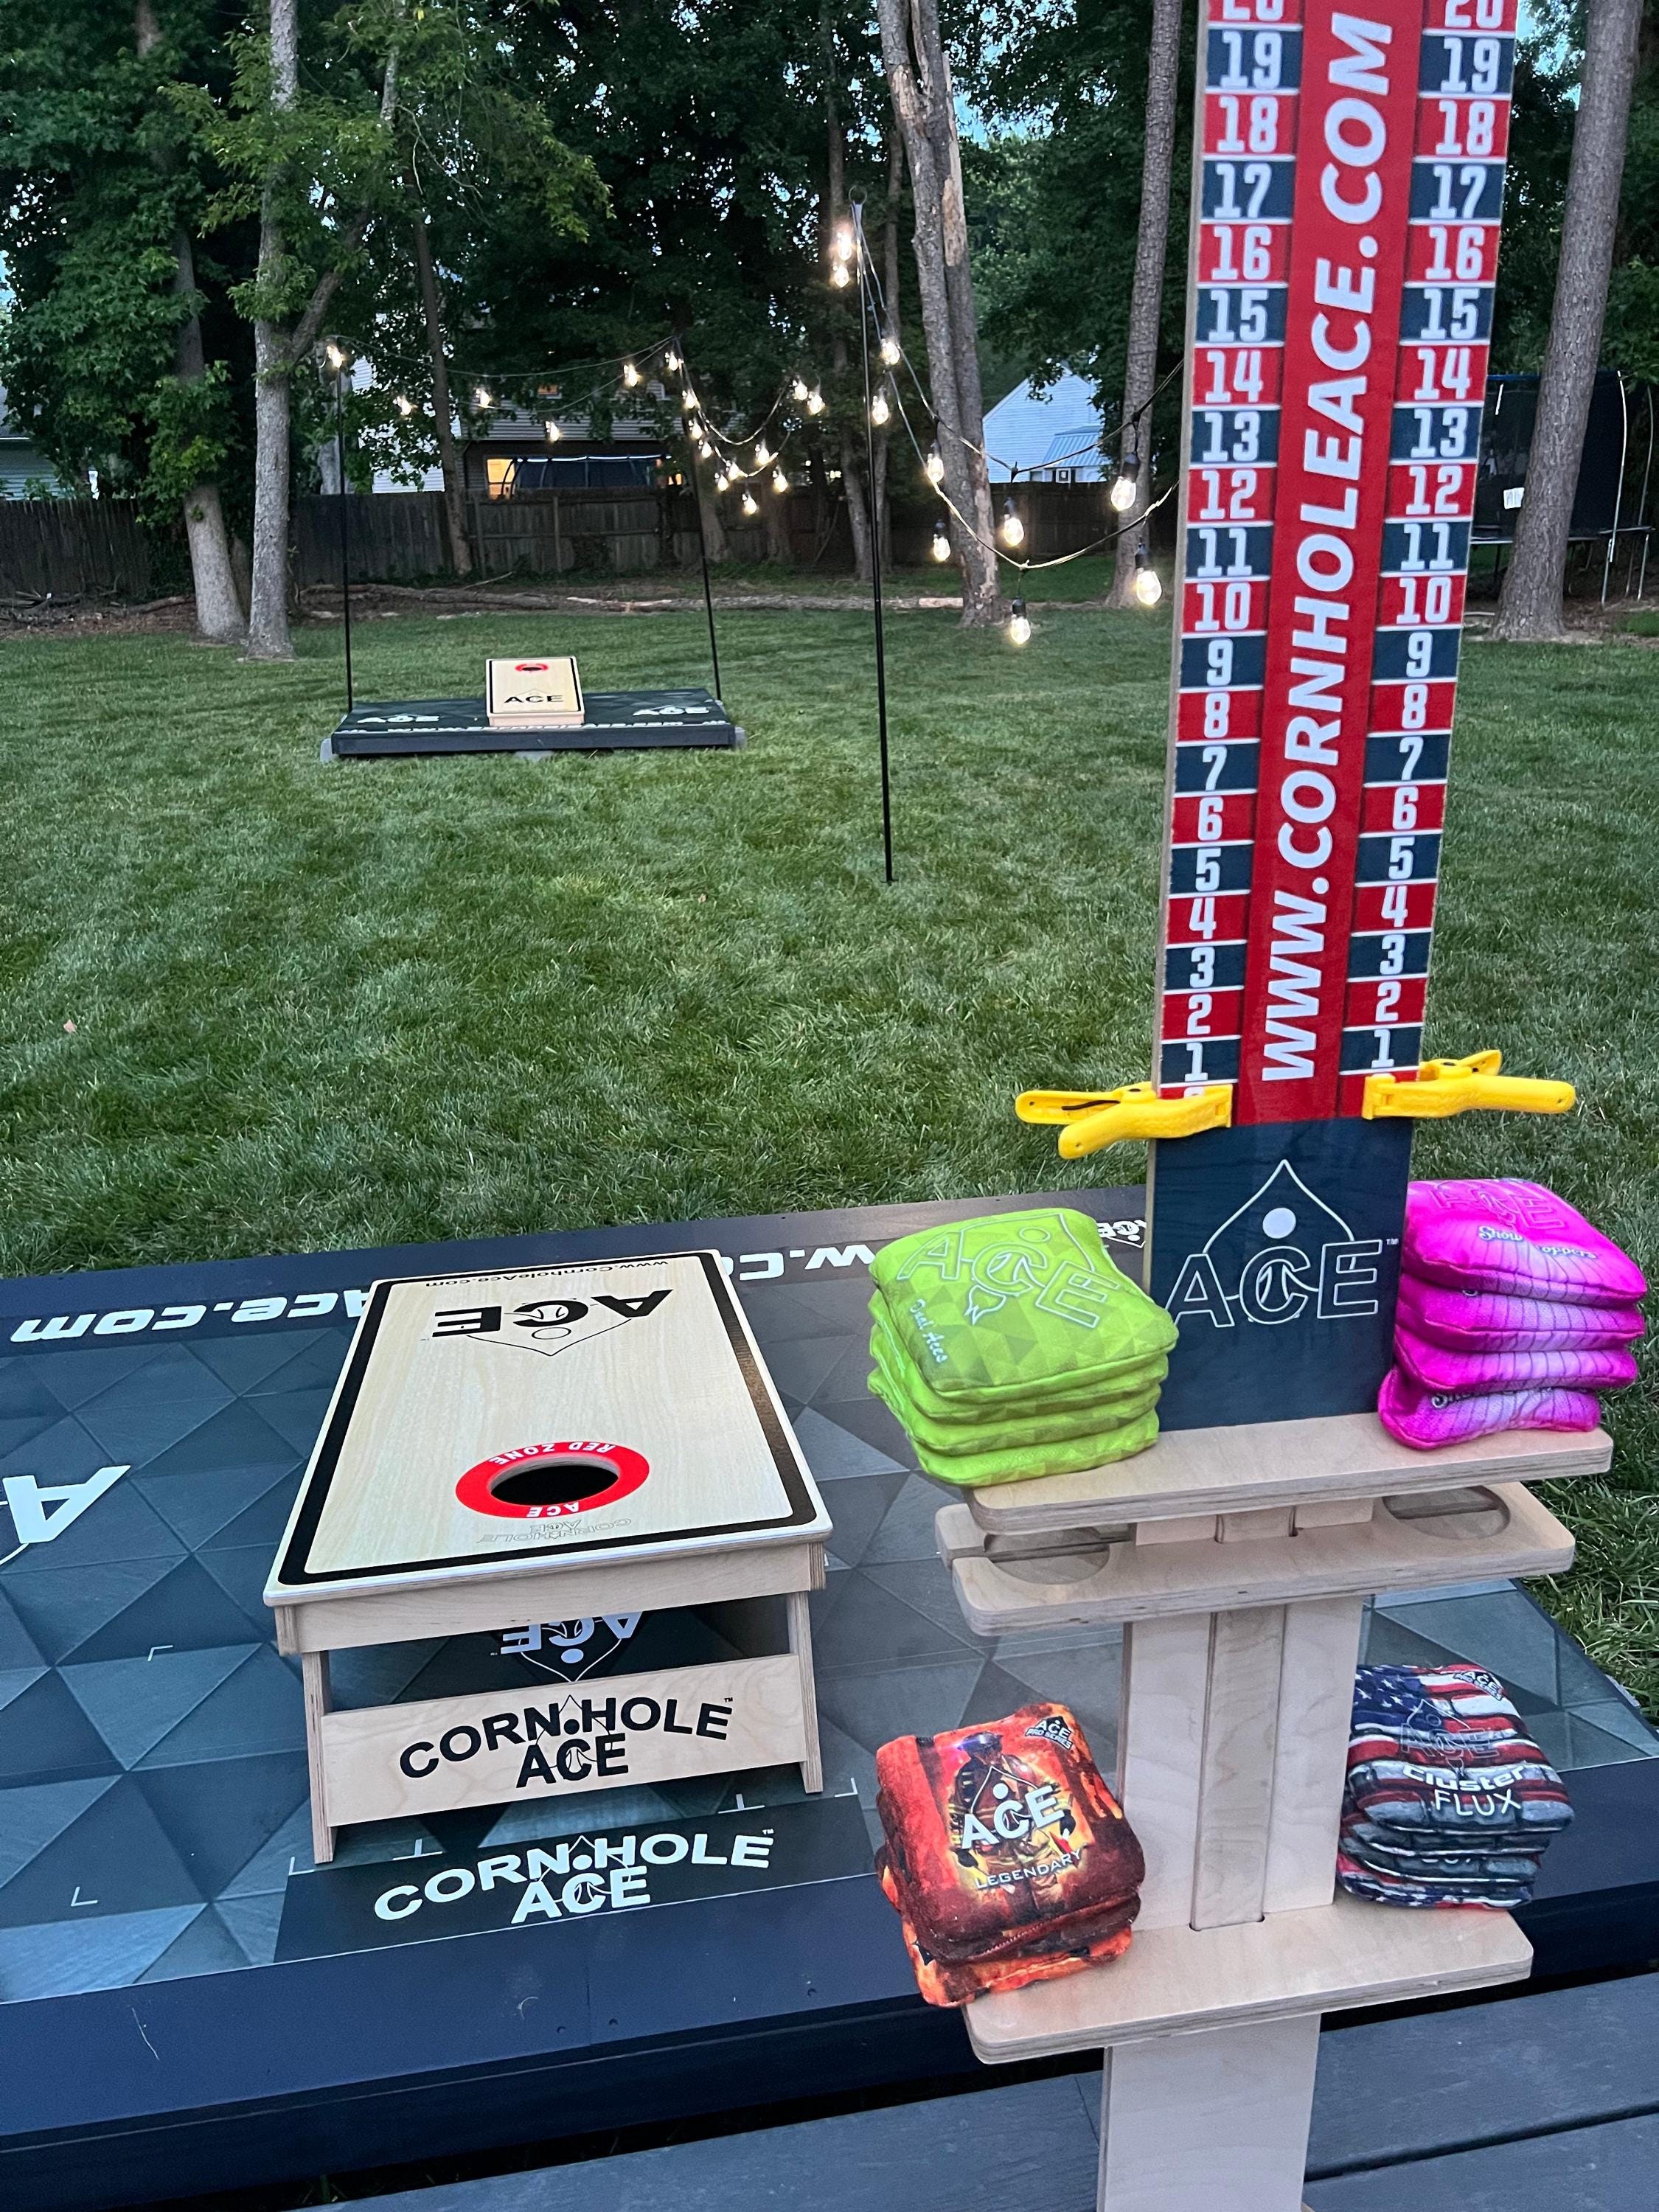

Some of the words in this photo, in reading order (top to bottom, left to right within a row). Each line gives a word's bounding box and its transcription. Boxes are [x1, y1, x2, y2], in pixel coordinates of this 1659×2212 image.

[1220, 31, 1283, 89] 19
[1441, 37, 1502, 94] 19
[1217, 95, 1280, 153] 18
[1436, 100, 1495, 156] 18
[1214, 163, 1272, 219] 17
[1430, 164, 1487, 219] 17
[1211, 226, 1271, 280] 16
[1425, 226, 1484, 280] 16
[1208, 290, 1268, 342] 15
[1420, 289, 1480, 340] 15
[1205, 349, 1263, 404] 14
[1414, 348, 1471, 400] 14
[1203, 411, 1260, 462] 13
[1411, 408, 1468, 458] 13
[1200, 469, 1256, 520] 12
[1405, 465, 1463, 515] 12
[1197, 528, 1253, 576] 11
[1262, 13, 1393, 1082] WWW.CORNHOLEACE.COM
[1401, 523, 1453, 570] 11
[1194, 582, 1252, 631] 10
[1397, 577, 1452, 625] 10
[1207, 639, 1233, 686] 9
[1406, 632, 1432, 678] 9
[1204, 692, 1230, 738] 8
[1401, 684, 1429, 729] 8
[1203, 745, 1228, 791] 7
[1399, 737, 1424, 781] 7
[1197, 797, 1223, 841] 6
[1392, 787, 1418, 830] 6
[1195, 848, 1221, 891] 5
[1388, 838, 1414, 880] 5
[1189, 897, 1217, 940] 4
[1381, 885, 1408, 928] 4
[1189, 946, 1215, 988] 3
[1379, 934, 1404, 975] 3
[1187, 994, 1213, 1034] 2
[1375, 981, 1402, 1023] 2
[1184, 1042, 1208, 1082] 1
[1371, 1030, 1396, 1068] 1
[897, 1229, 1121, 1329] ACE
[1165, 1239, 1383, 1327] ACE
[432, 1289, 673, 1338] ACE
[488, 1443, 555, 1465] ZONE
[568, 1441, 616, 1453] RED
[526, 1501, 580, 1518] ACE
[1035, 1719, 1071, 1739] ACE
[516, 1732, 629, 1788] ACE
[961, 1785, 1065, 1849] ACE
[1434, 1789, 1522, 1816] FLUX
[975, 1849, 1083, 1889] LEGENDARY
[511, 1865, 651, 1924] ACE
